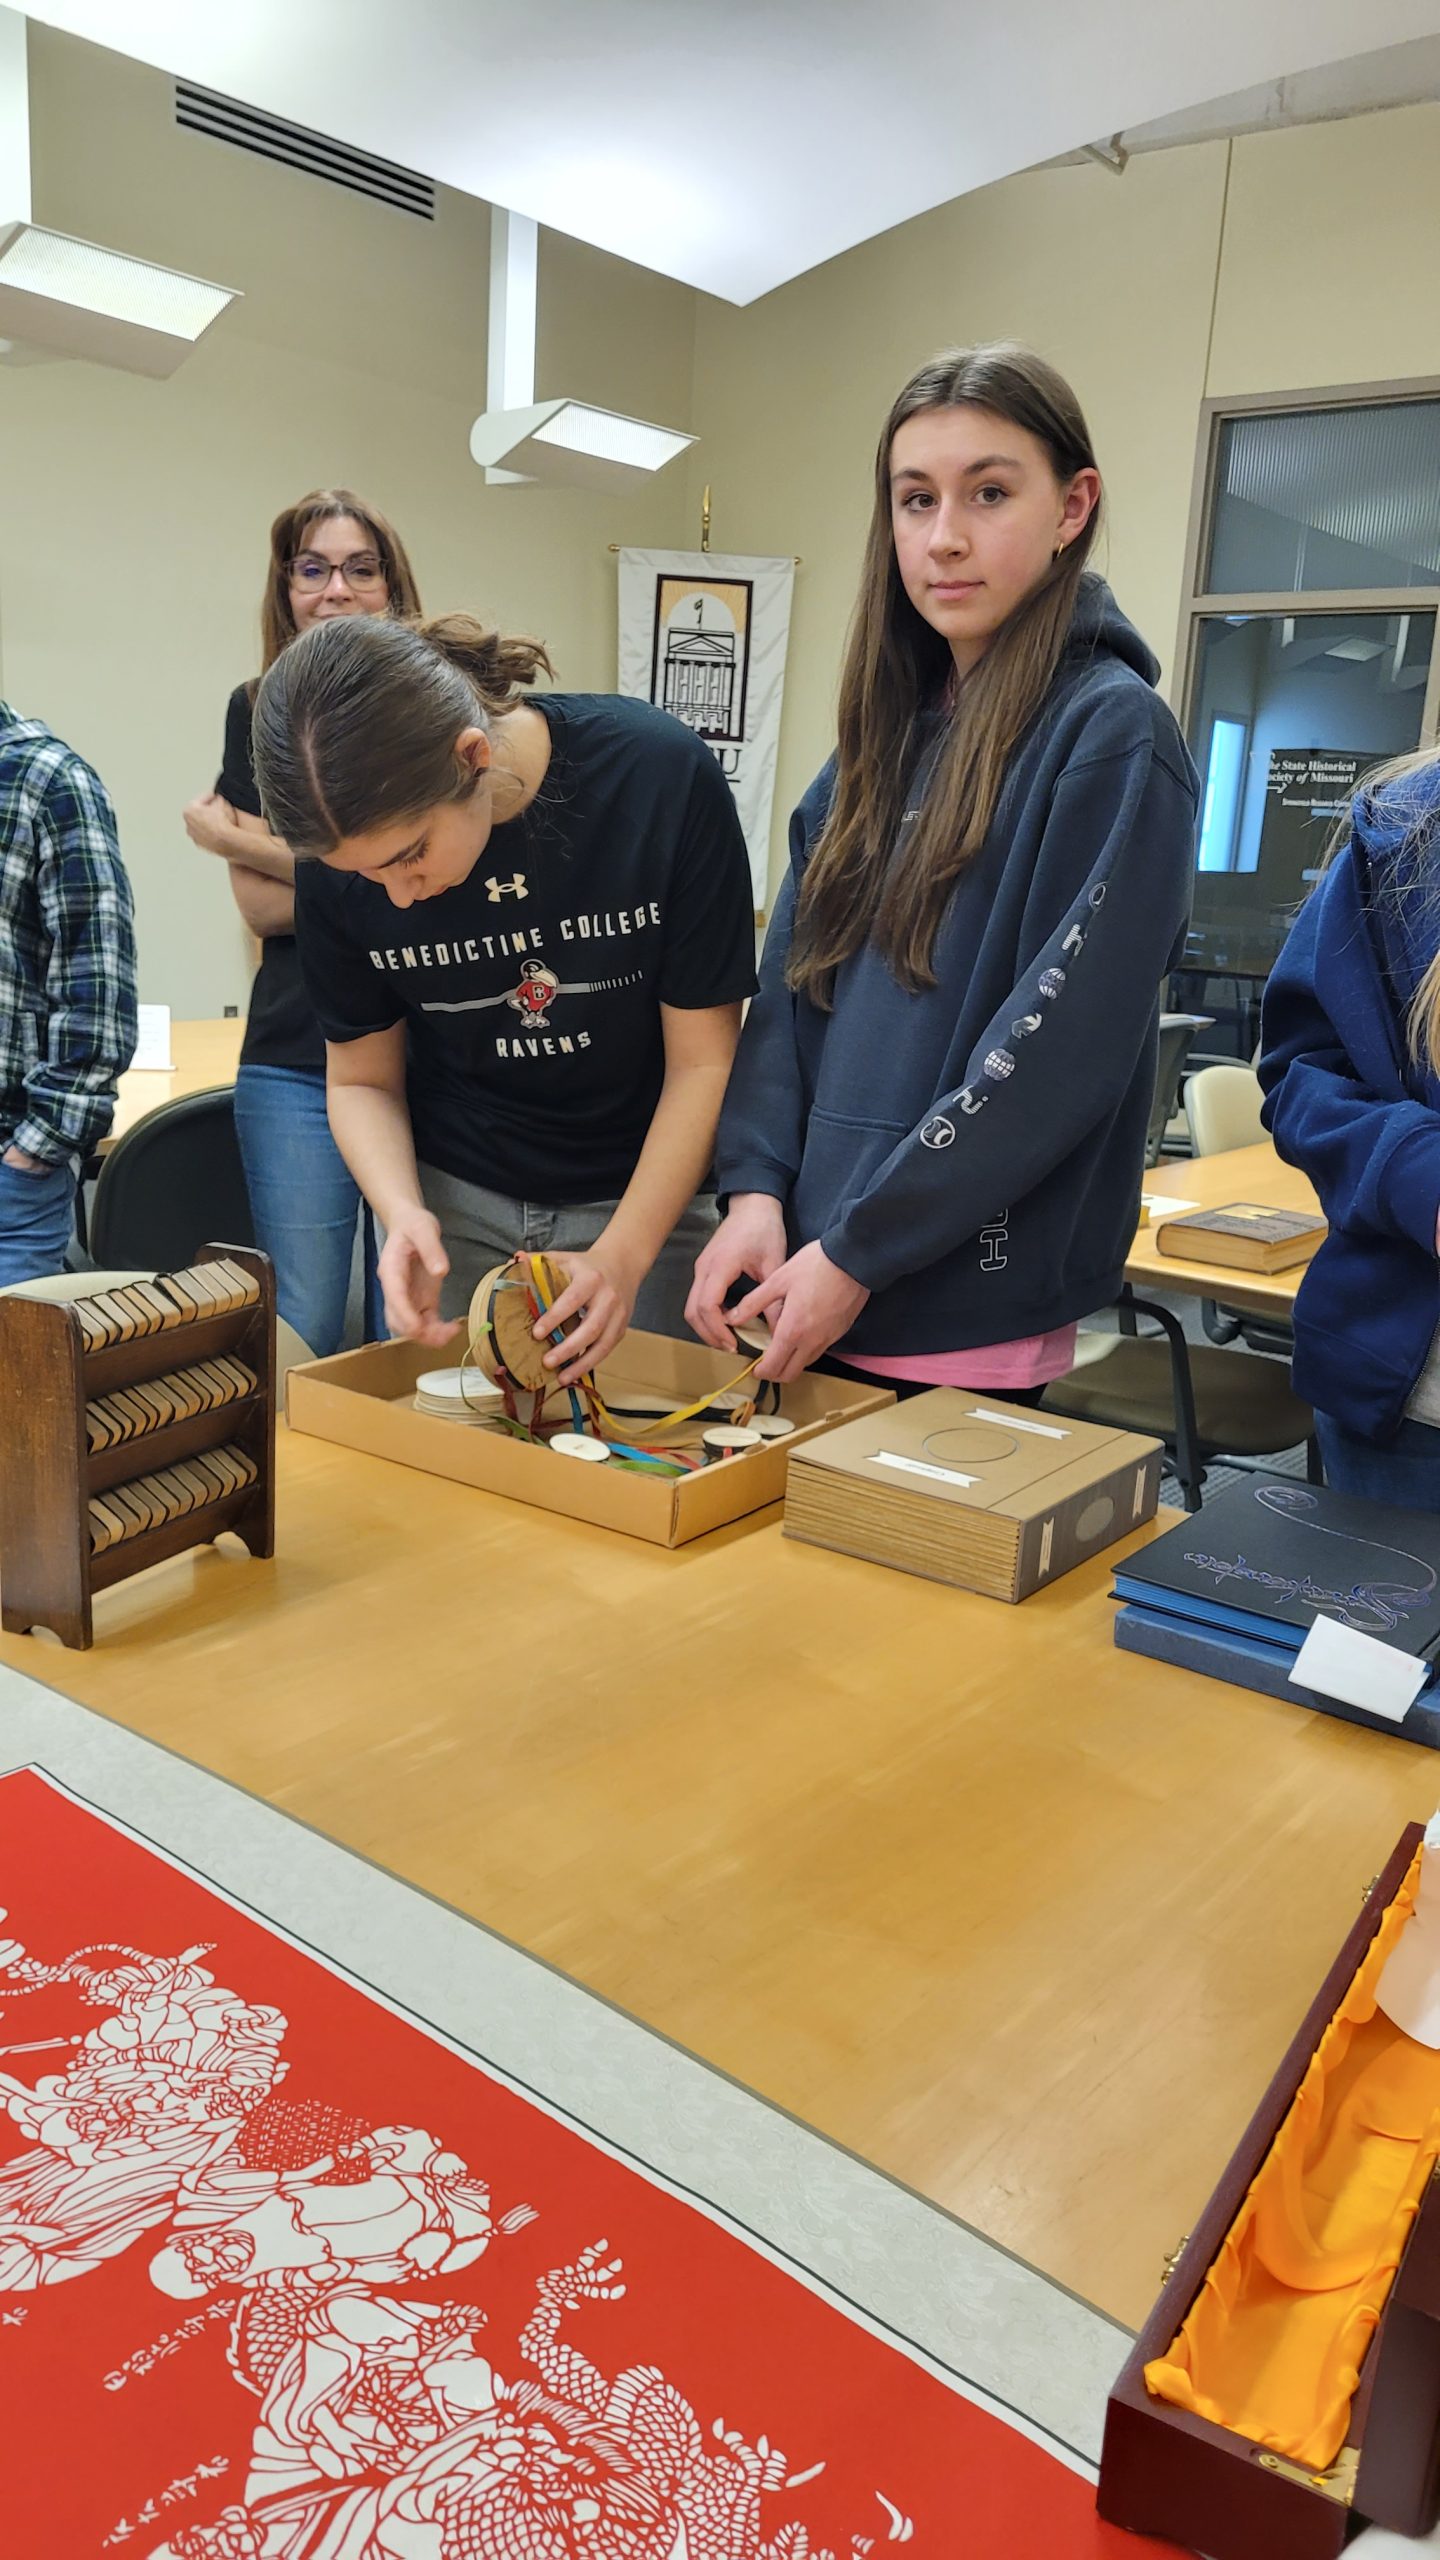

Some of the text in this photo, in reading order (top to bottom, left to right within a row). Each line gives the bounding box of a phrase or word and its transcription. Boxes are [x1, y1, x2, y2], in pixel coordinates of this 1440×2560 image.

[1281, 760, 1307, 771] State
[1308, 760, 1357, 772] Historical
[1296, 772, 1309, 784] of
[1310, 772, 1354, 783] Missouri
[369, 901, 662, 970] BENEDICTINE COLLEGE
[496, 1030, 592, 1058] RAVENS
